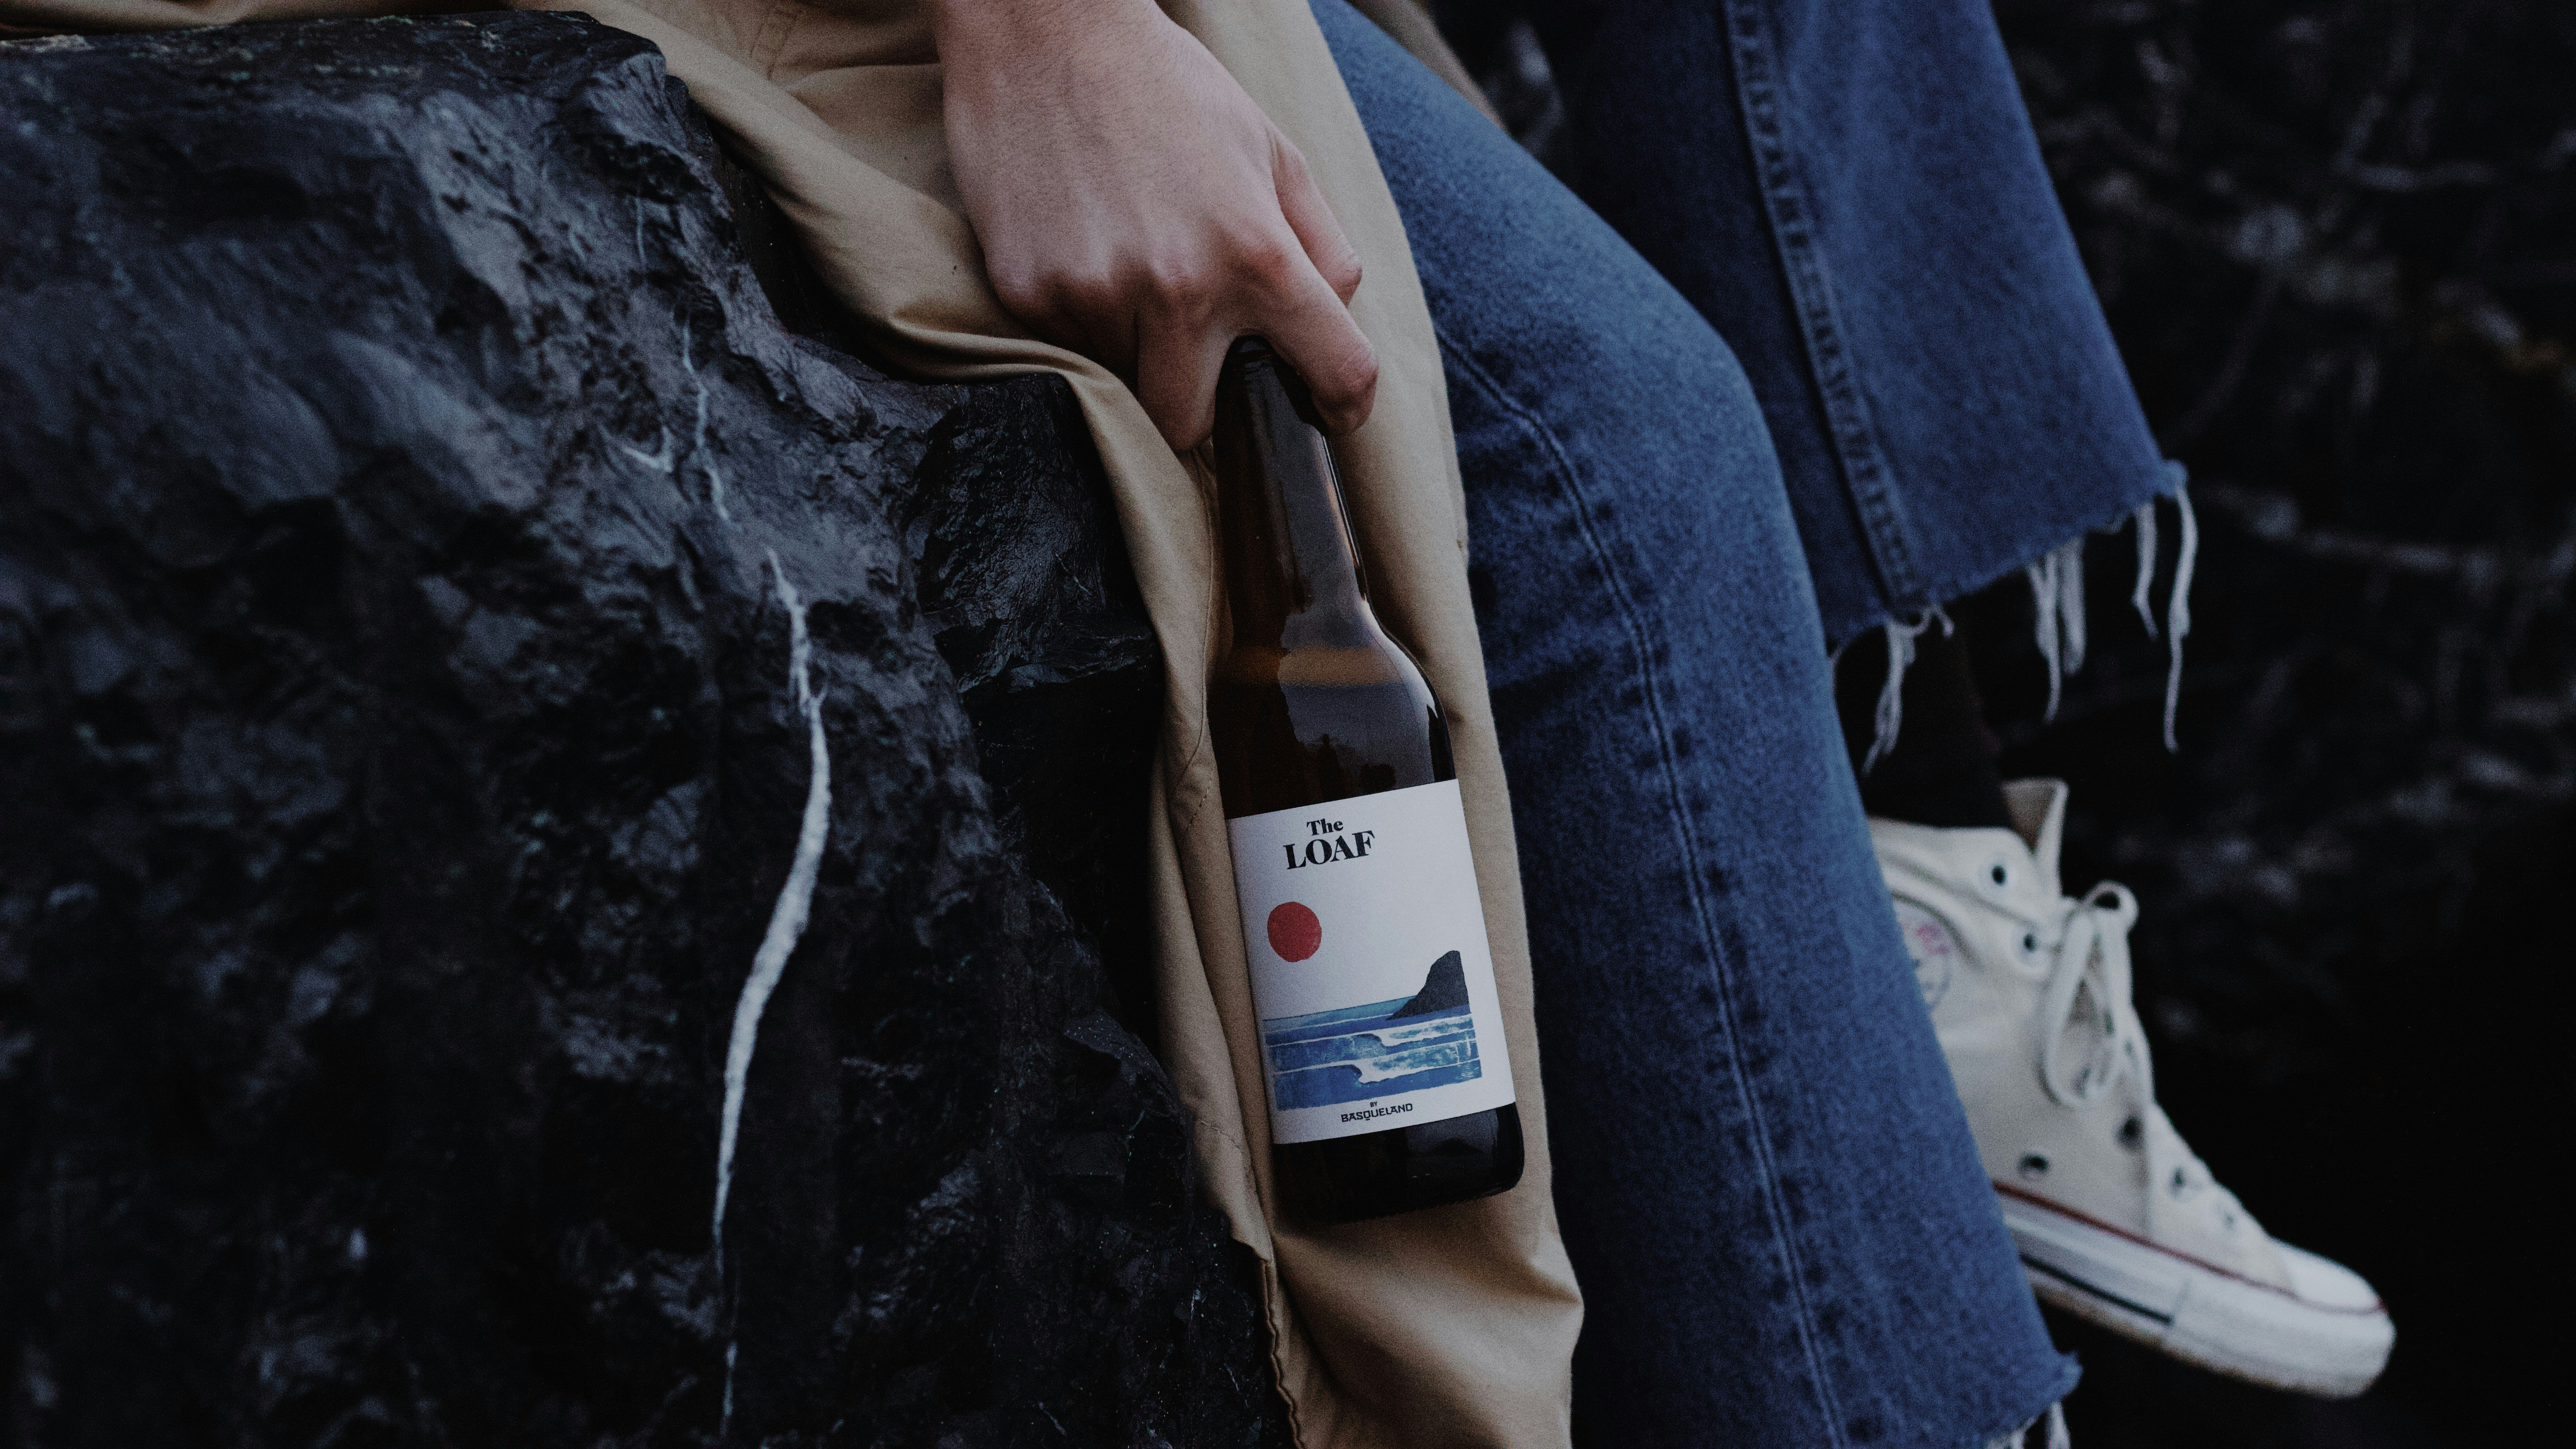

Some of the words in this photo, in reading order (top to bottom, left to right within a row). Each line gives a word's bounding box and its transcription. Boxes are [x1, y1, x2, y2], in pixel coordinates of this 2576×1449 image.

[1307, 818, 1344, 835] The
[1283, 830, 1375, 870] LOAF
[1341, 1103, 1413, 1122] BASQUELAND
